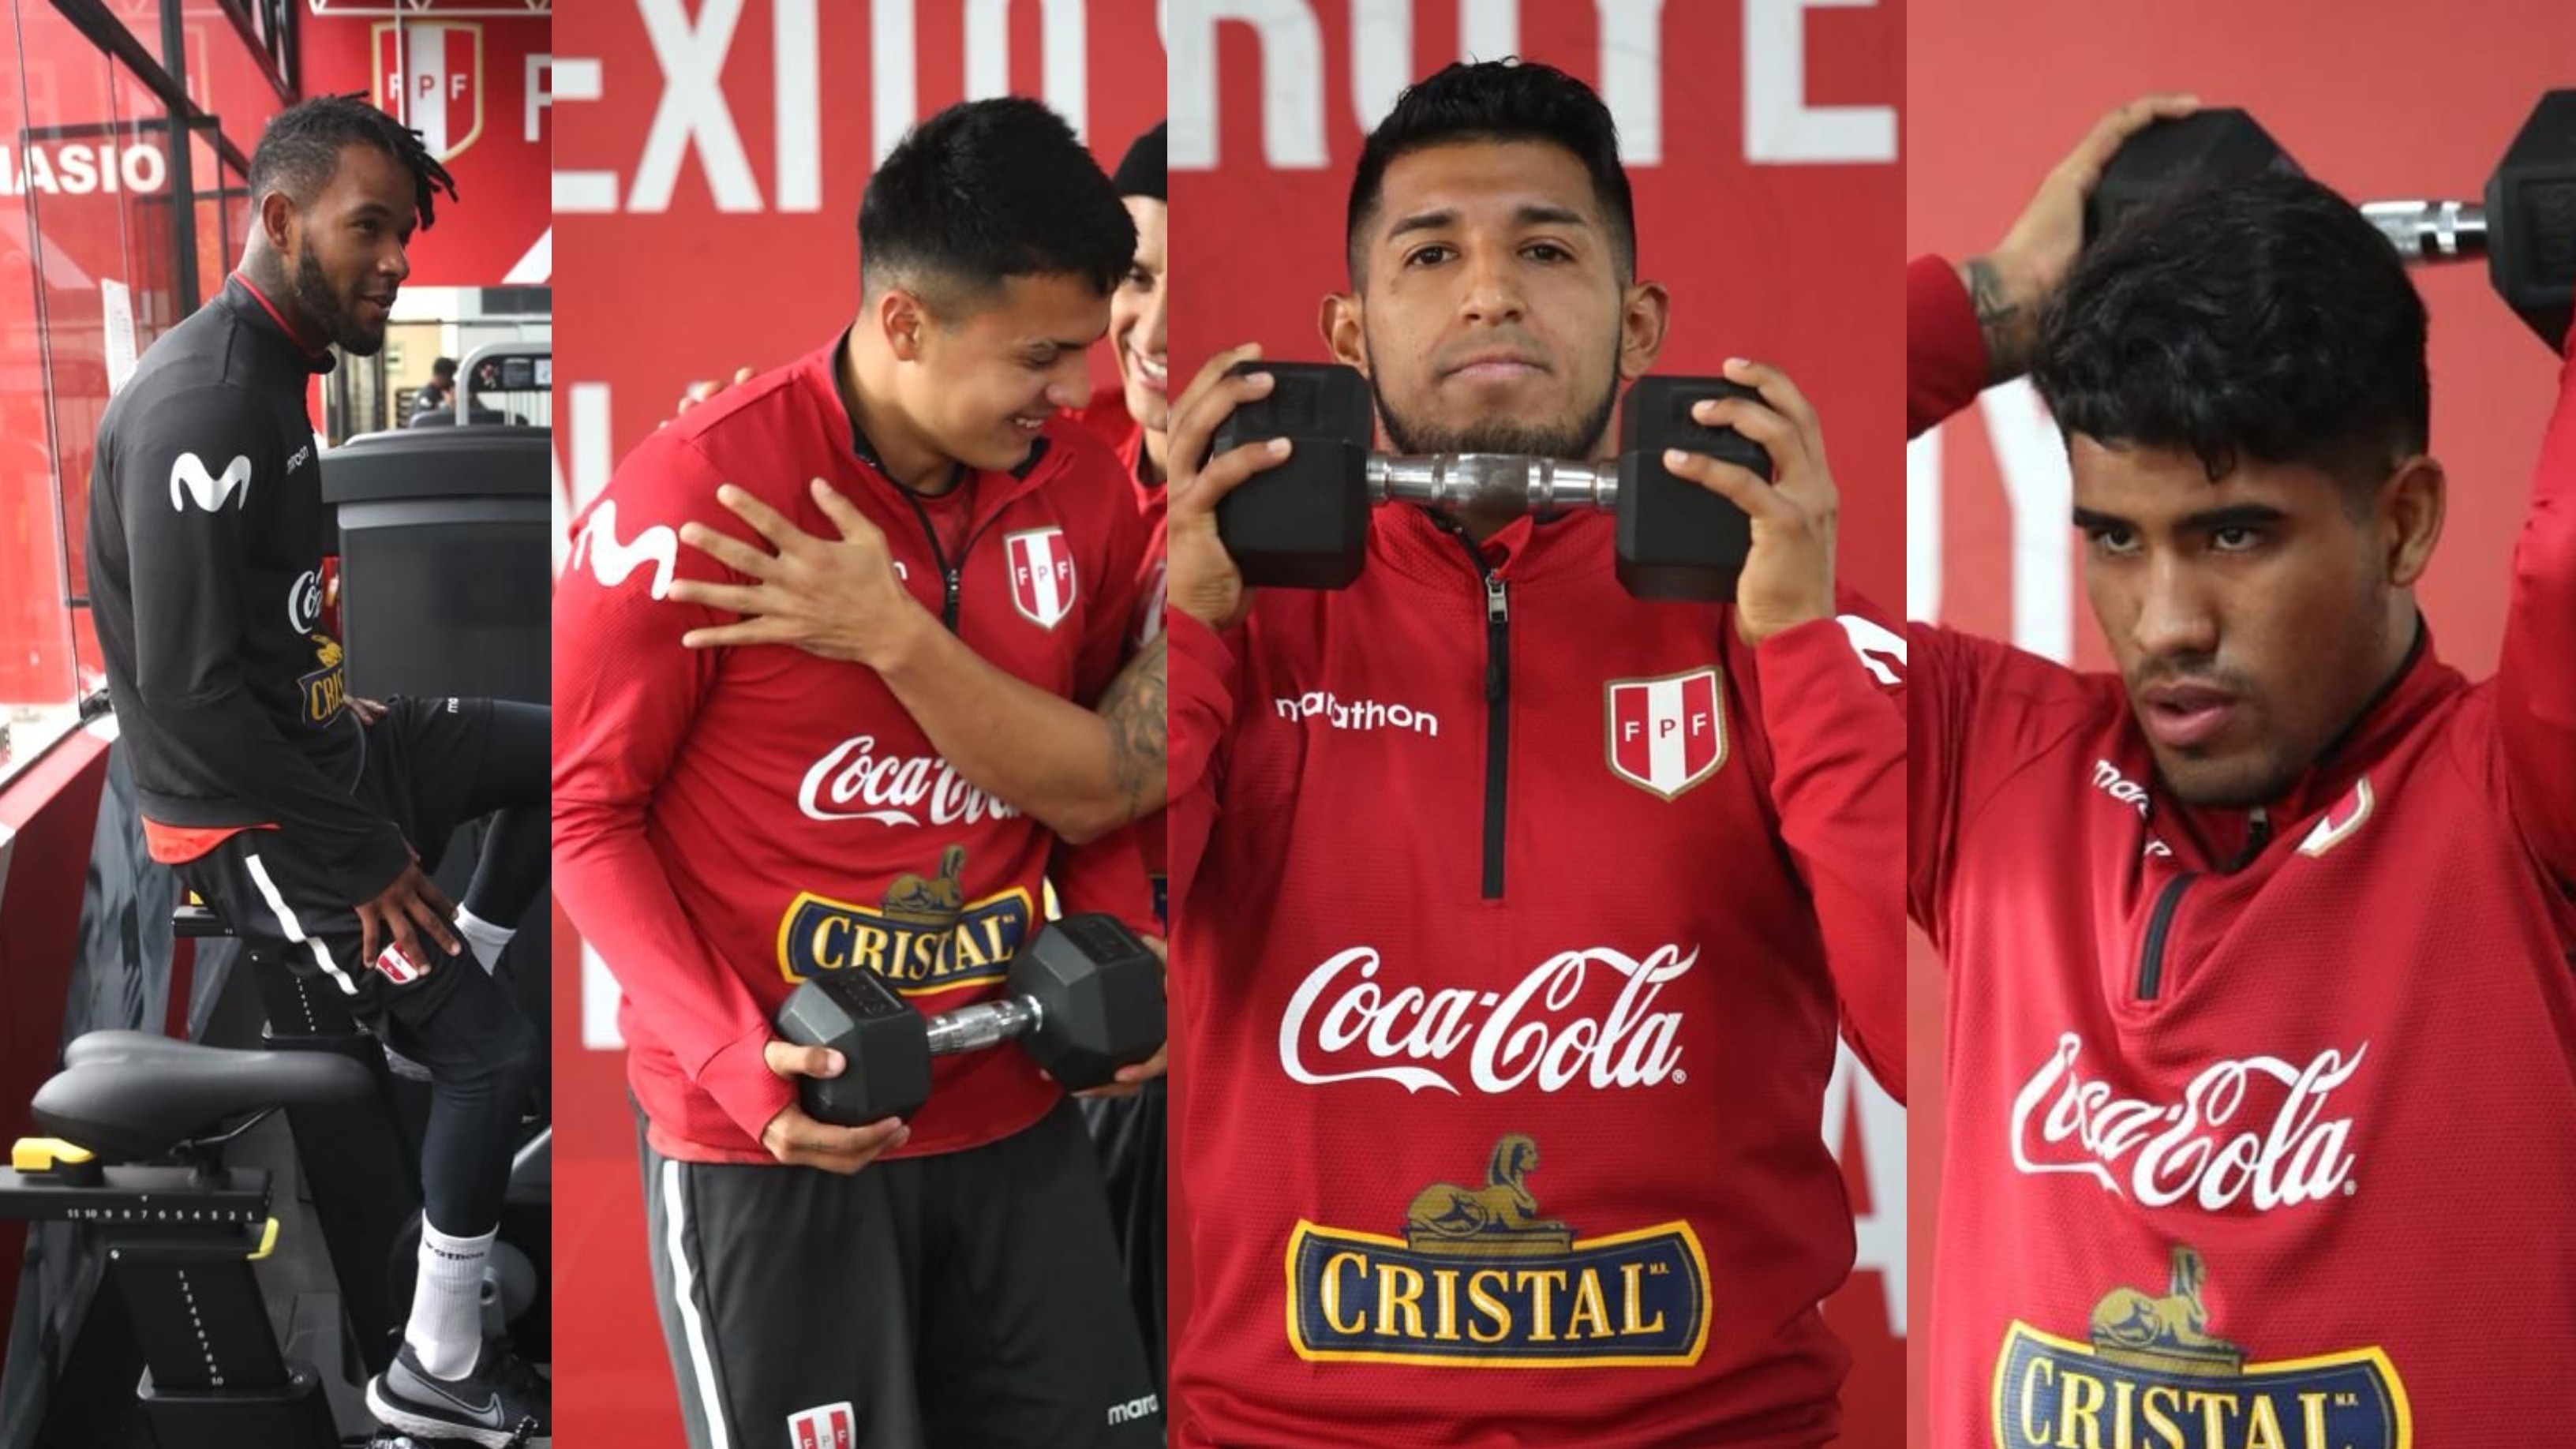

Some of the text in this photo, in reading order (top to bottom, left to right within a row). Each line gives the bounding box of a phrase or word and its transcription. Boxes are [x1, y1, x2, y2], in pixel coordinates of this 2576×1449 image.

[0, 144, 166, 195] ASIO
[1625, 712, 1707, 742] FPF
[1279, 942, 1700, 1095] Coca-Cola
[1320, 1252, 1664, 1342] CRISTAL
[2020, 1356, 2354, 1449] CRISTAL
